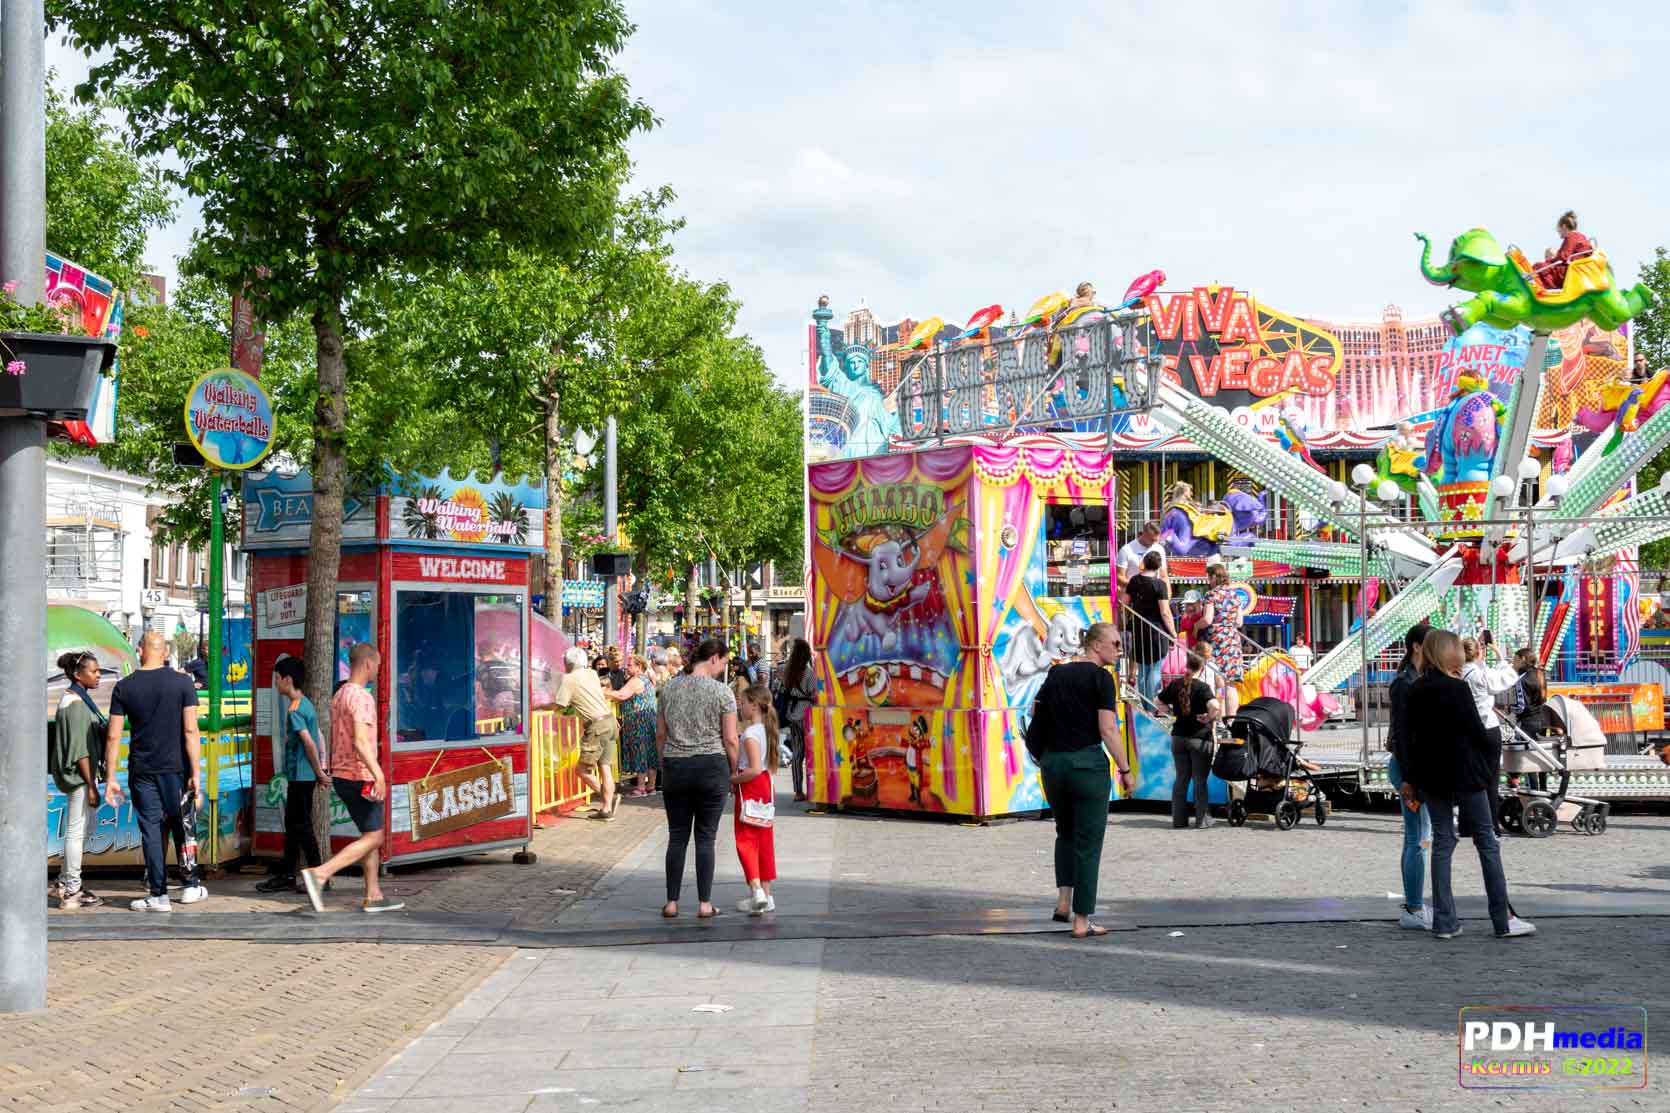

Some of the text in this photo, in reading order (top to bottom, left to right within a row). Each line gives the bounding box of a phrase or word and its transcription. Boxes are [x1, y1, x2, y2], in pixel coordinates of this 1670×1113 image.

[1149, 287, 1260, 343] VIVA
[1189, 349, 1337, 397] VEGAS
[1434, 344, 1508, 380] PLANET
[416, 498, 482, 522] Walking
[435, 515, 518, 536] Waterballs
[838, 486, 938, 534] JUMBO
[418, 556, 506, 580] WELCOME
[418, 772, 509, 826] KASSA
